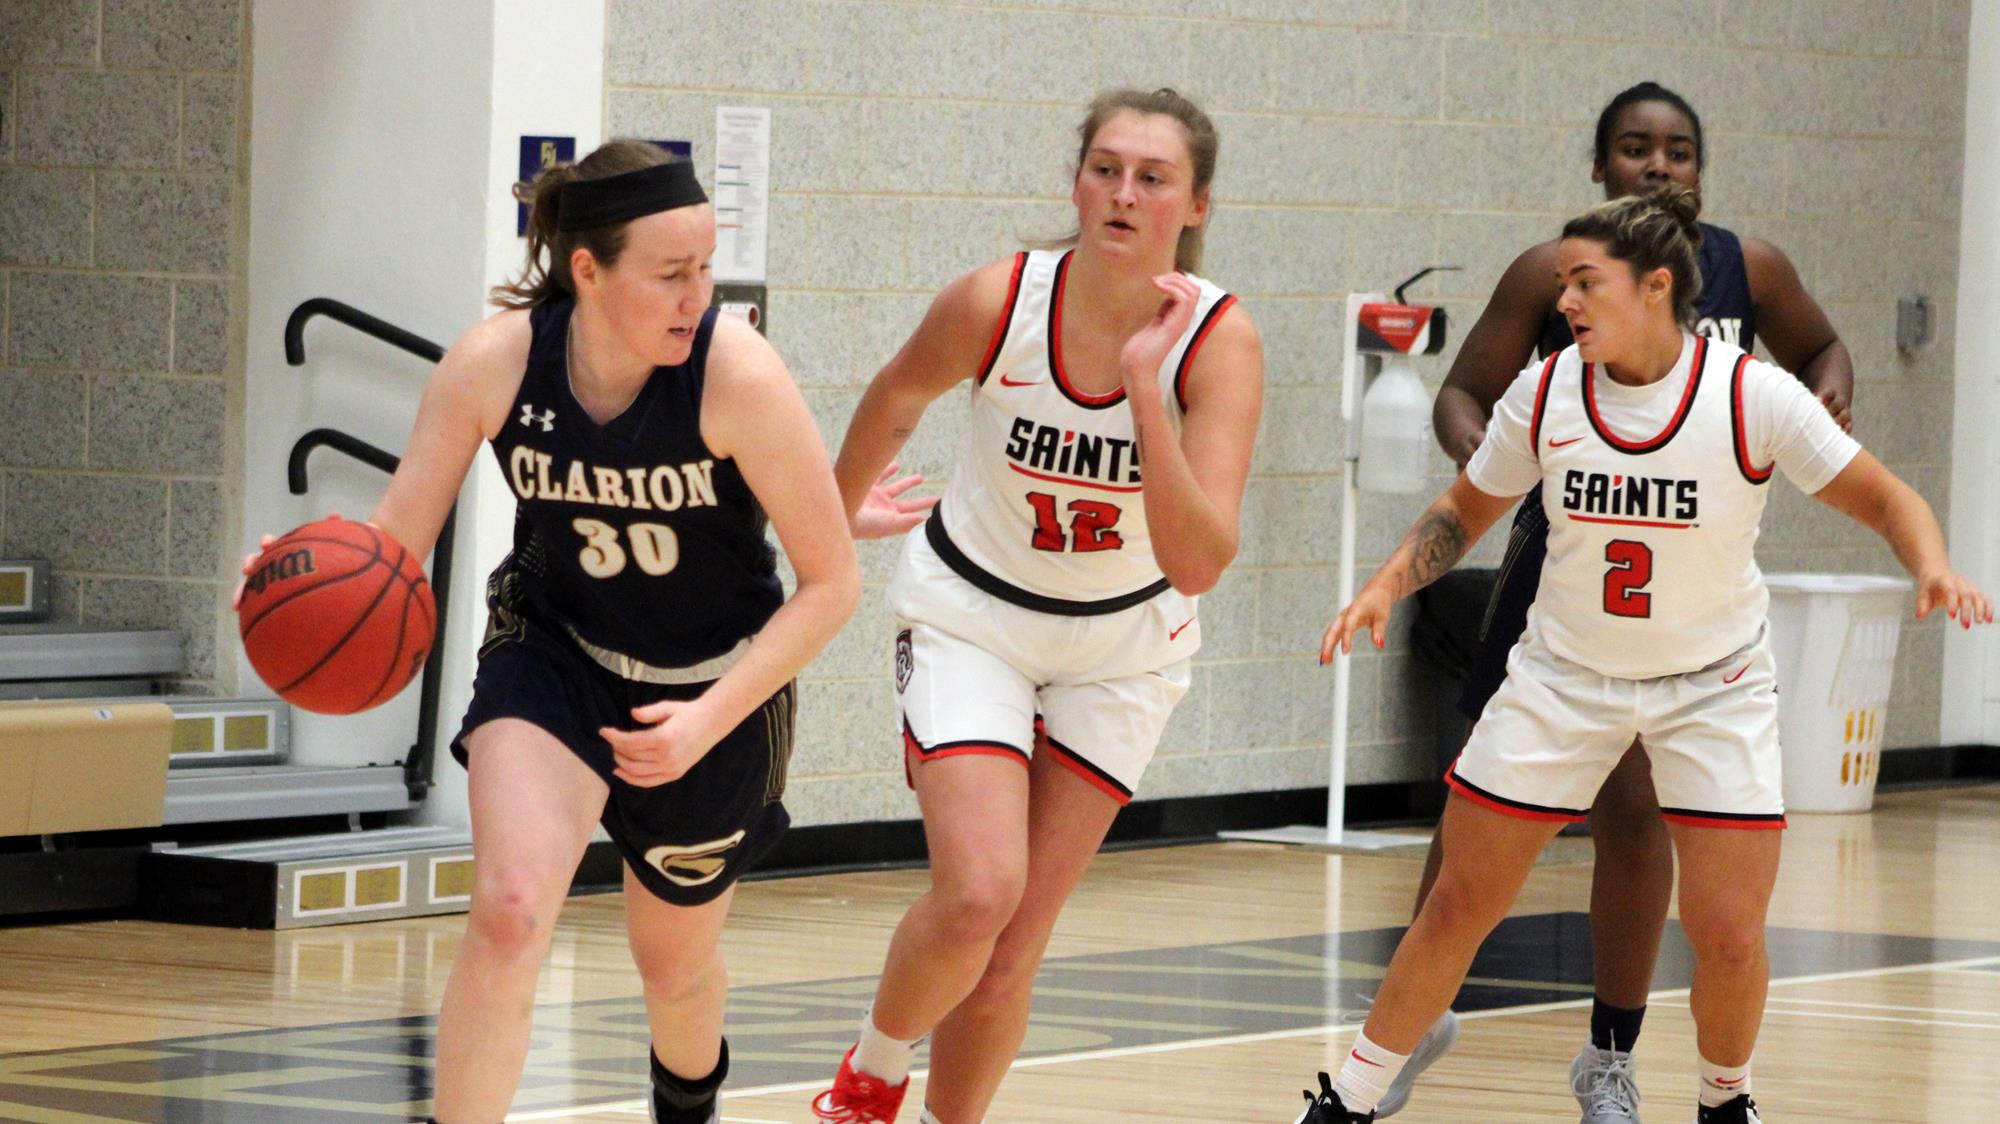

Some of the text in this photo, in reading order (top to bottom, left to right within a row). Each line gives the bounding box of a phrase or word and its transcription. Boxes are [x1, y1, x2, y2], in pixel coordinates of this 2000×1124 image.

[510, 445, 719, 512] CLARION
[572, 517, 680, 579] 30
[1025, 491, 1124, 553] 12
[1603, 538, 1653, 619] 2
